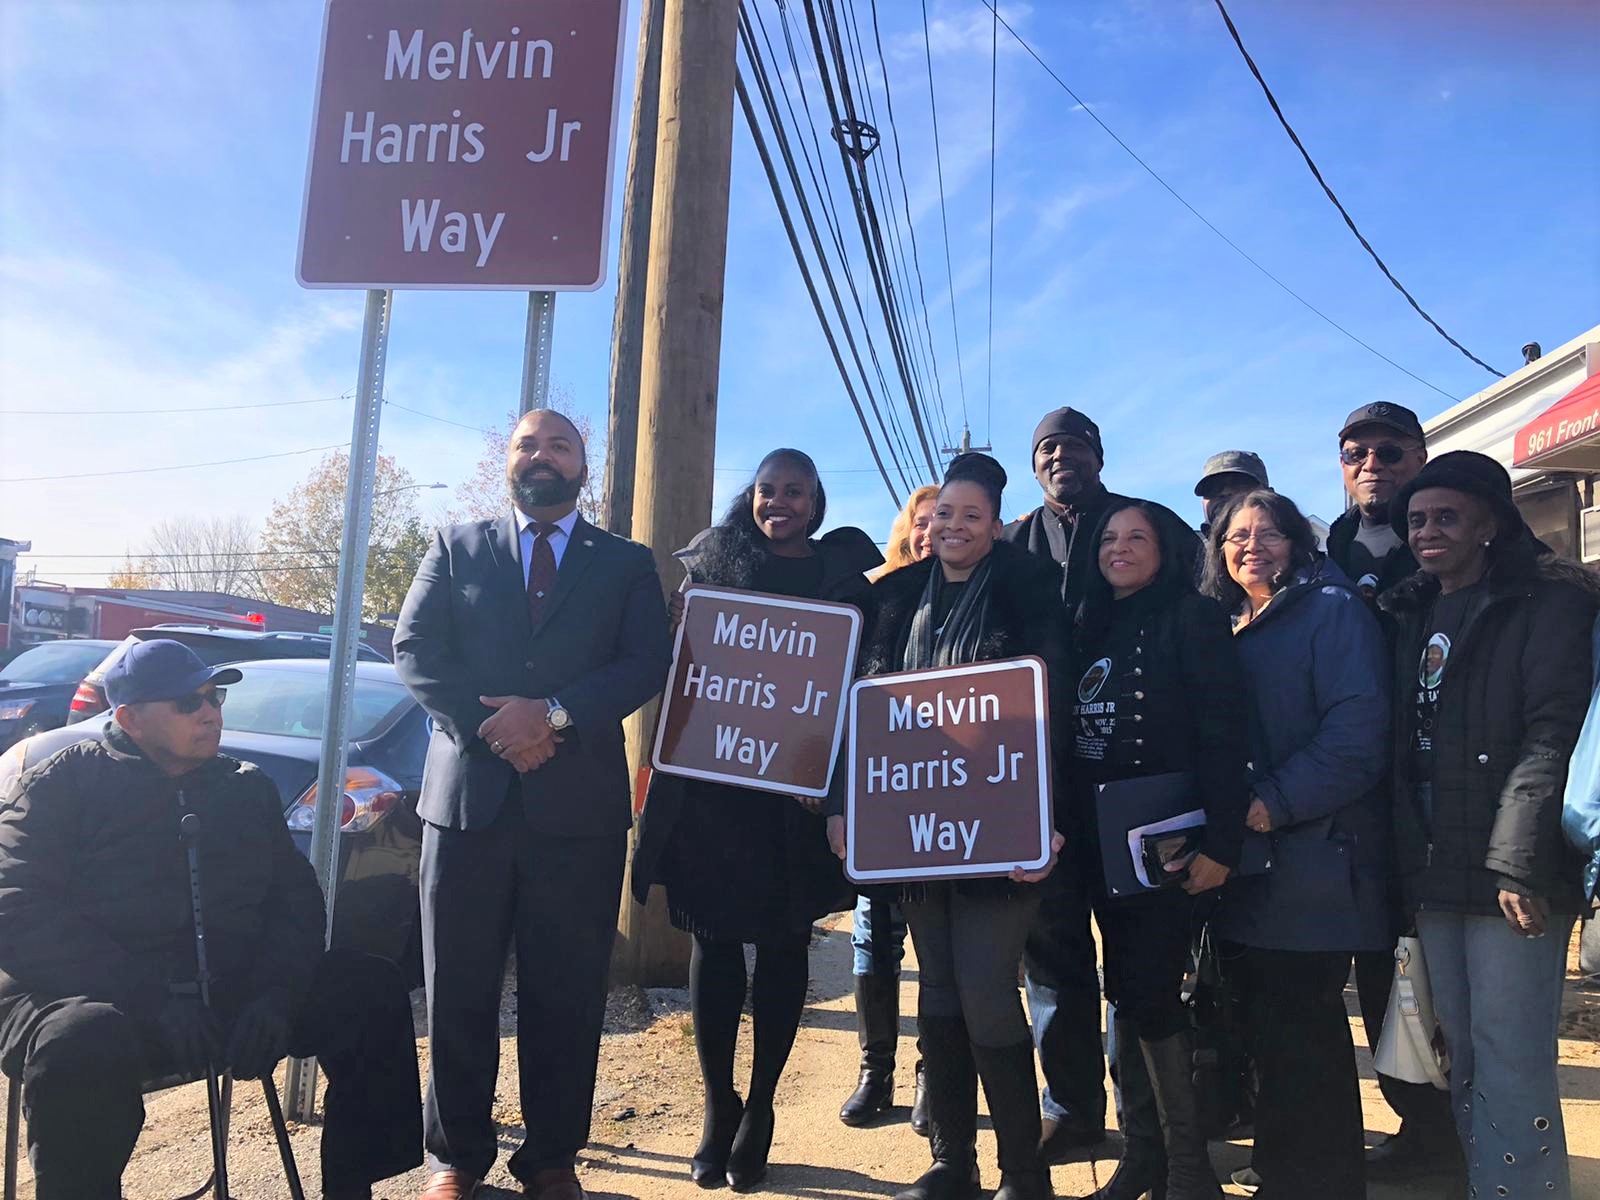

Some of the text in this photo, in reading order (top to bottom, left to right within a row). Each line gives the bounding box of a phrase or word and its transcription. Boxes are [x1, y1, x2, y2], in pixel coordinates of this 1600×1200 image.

[384, 26, 554, 81] Melvin
[340, 108, 582, 163] Harris Jr
[401, 198, 506, 268] Way
[1528, 410, 1599, 456] 961 Front
[712, 611, 817, 658] Melvin
[683, 663, 829, 717] Harris Jr
[888, 687, 1000, 733] Melvin
[1080, 702, 1104, 714] HARRIS
[1105, 702, 1115, 713] JR
[714, 724, 779, 776] Way
[867, 744, 1024, 794] Harris Jr
[909, 812, 981, 860] Way
